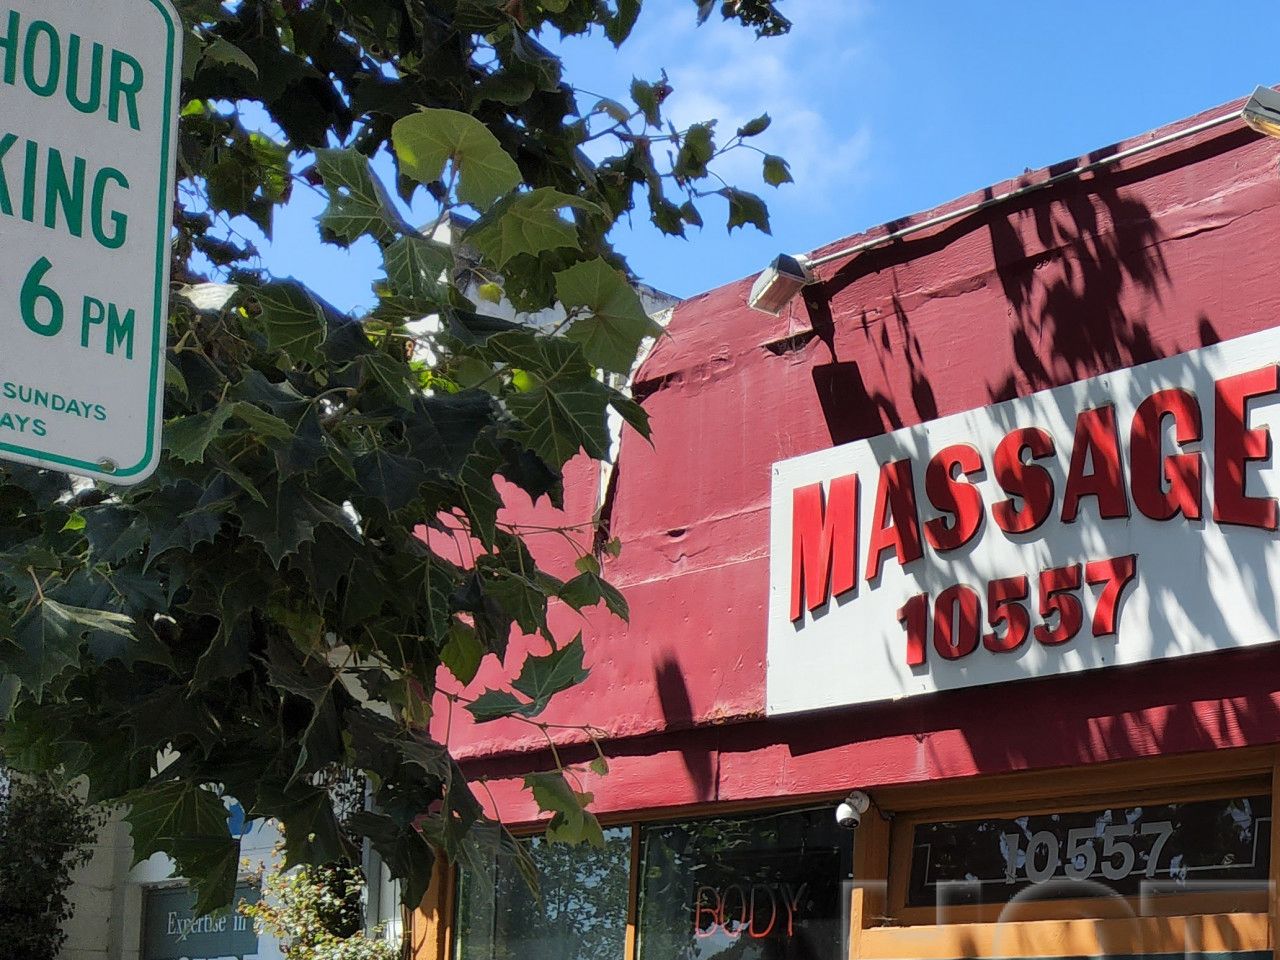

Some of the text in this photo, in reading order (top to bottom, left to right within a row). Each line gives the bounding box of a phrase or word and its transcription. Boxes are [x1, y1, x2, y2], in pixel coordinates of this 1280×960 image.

[20, 256, 136, 360] 6 PM
[3, 382, 107, 422] SUNDAYS
[896, 554, 1138, 668] 10557
[1004, 821, 1174, 885] 10557
[233, 914, 246, 931] in
[694, 883, 807, 938] BODY
